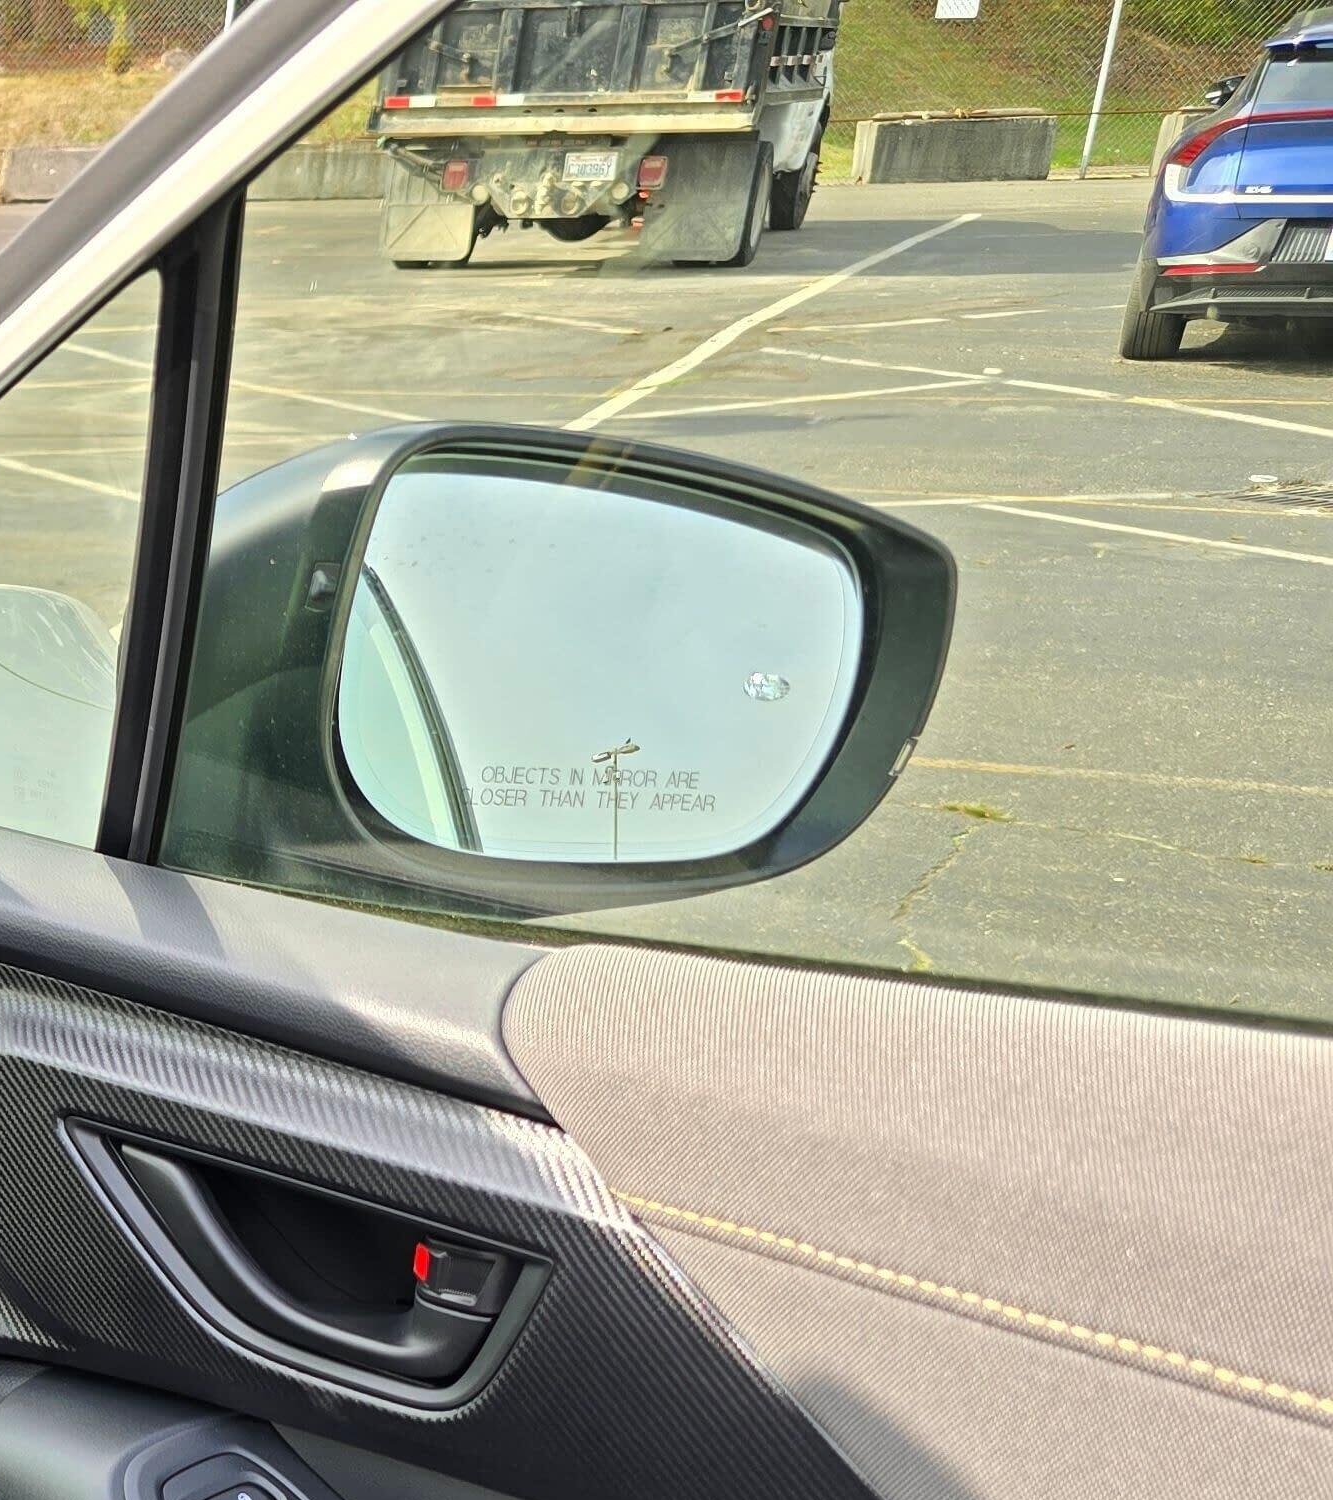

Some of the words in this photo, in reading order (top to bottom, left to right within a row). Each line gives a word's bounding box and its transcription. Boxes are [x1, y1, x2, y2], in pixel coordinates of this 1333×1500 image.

[482, 766, 561, 785] OBJECTS
[569, 768, 583, 785] IN
[666, 771, 701, 790] ARE
[540, 789, 585, 808] THAN
[597, 790, 640, 809] THEY
[650, 793, 716, 812] APPEAR
